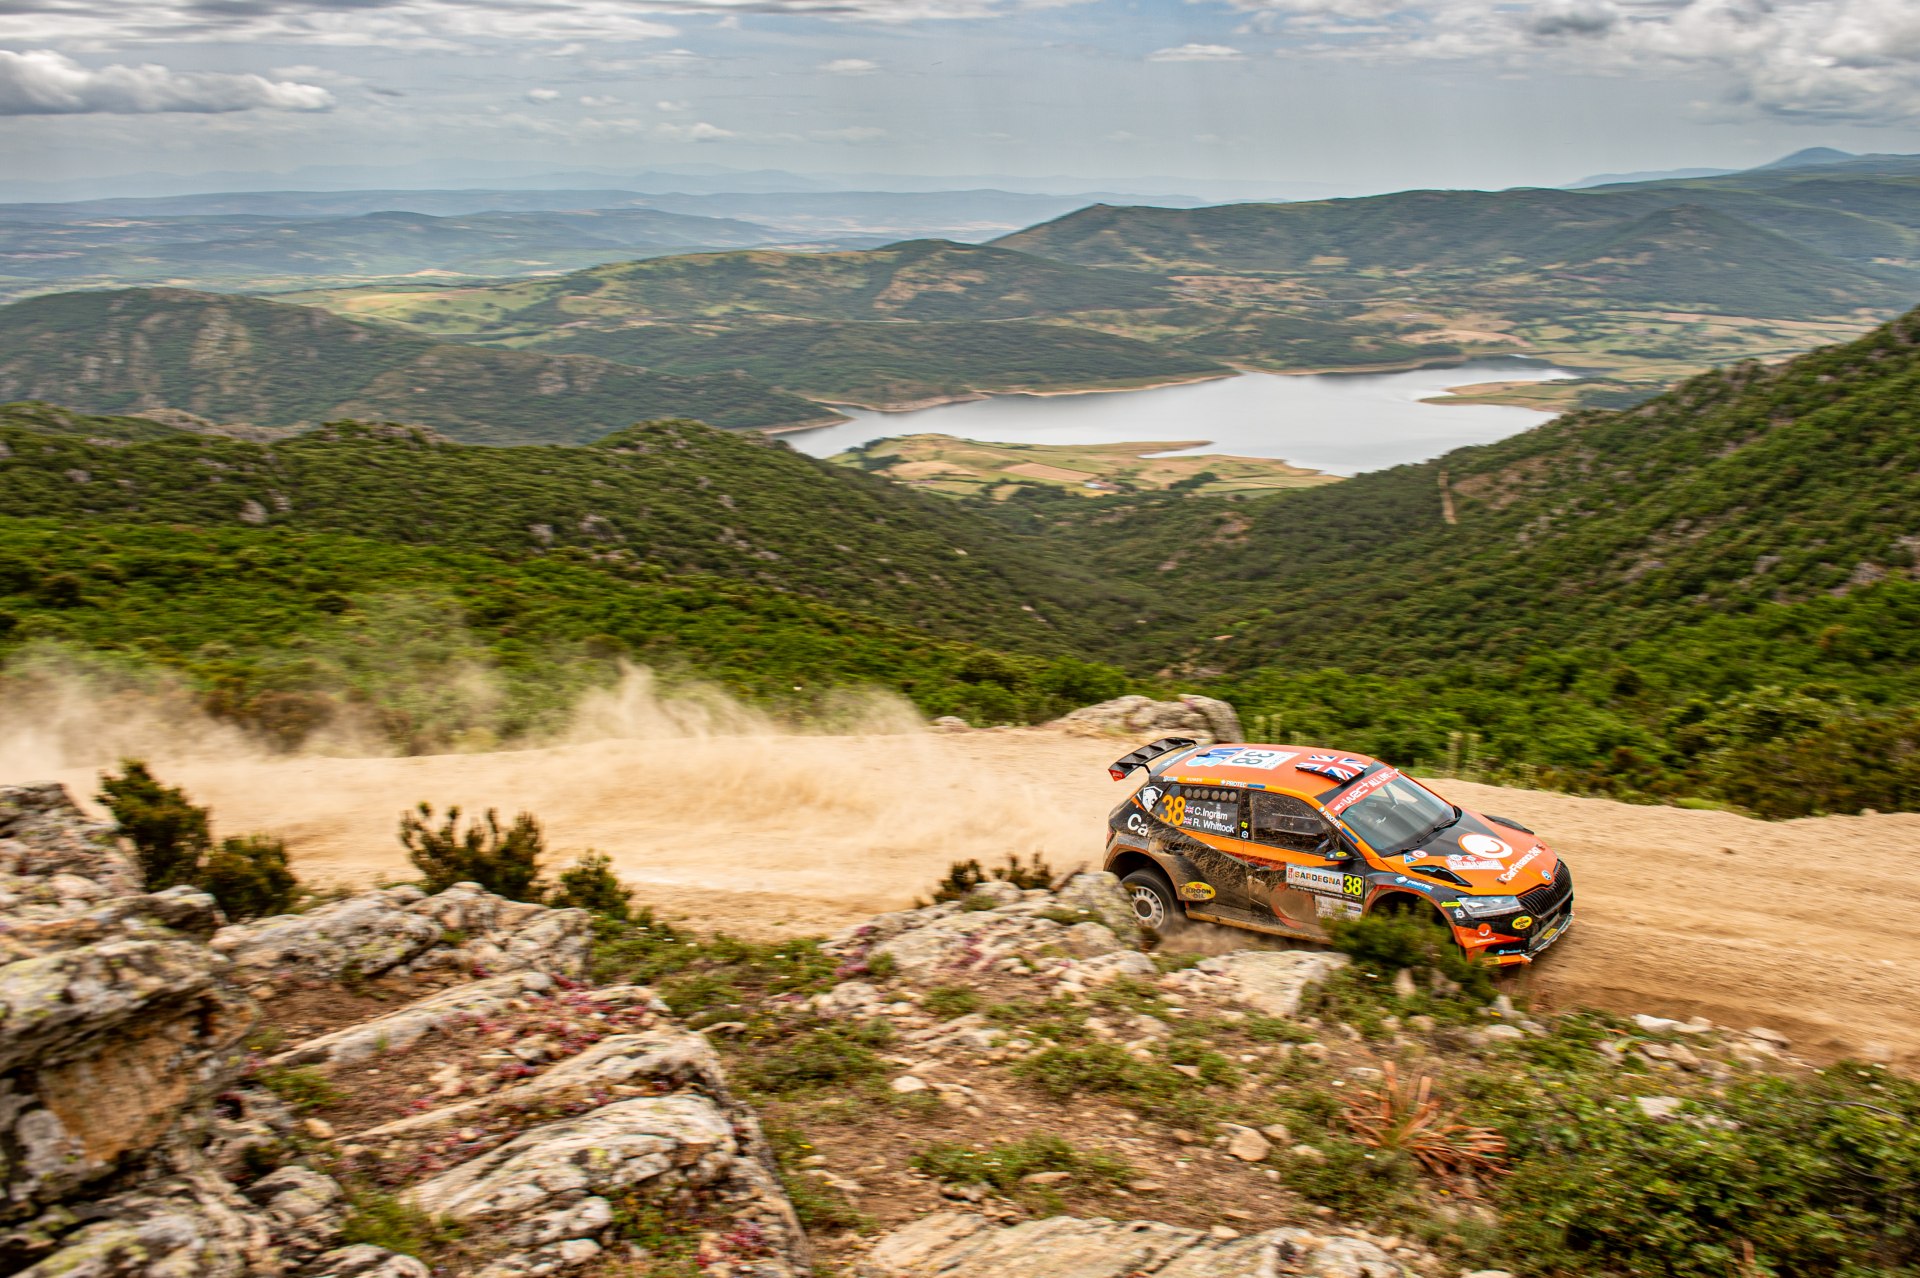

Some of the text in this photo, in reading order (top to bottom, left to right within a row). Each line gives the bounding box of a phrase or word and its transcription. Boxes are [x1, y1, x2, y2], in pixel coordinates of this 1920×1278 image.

[1231, 751, 1275, 765] 38
[1159, 794, 1186, 826] 38
[1192, 818, 1235, 833] R. Whittock
[1323, 810, 1343, 829] PROTEC
[1185, 887, 1212, 895] KROON
[1294, 871, 1341, 886] SARDEGNA
[1343, 874, 1362, 896] 38
